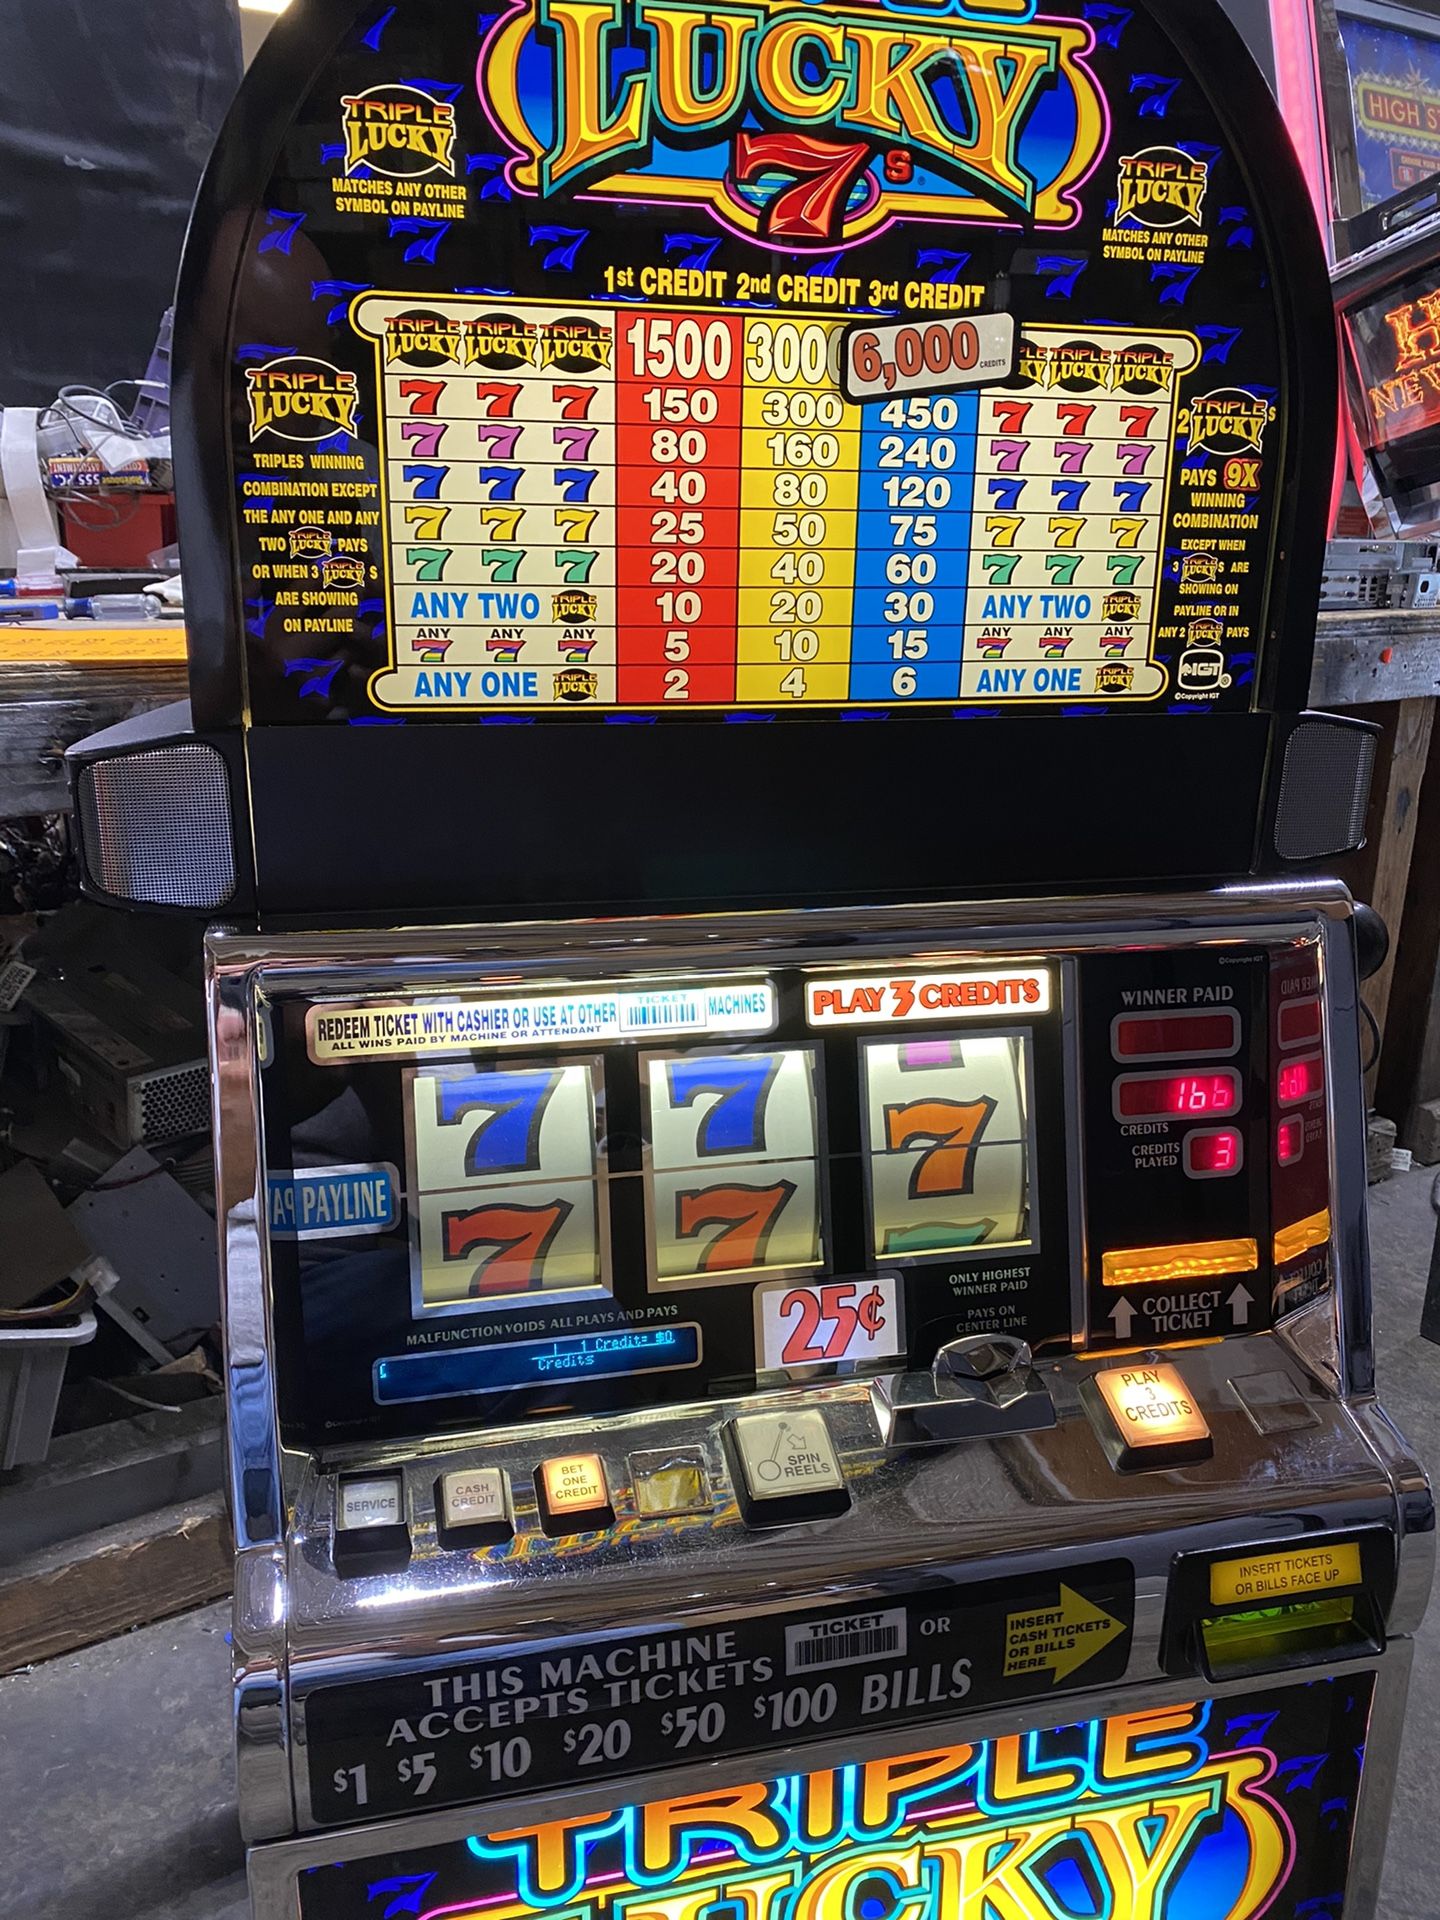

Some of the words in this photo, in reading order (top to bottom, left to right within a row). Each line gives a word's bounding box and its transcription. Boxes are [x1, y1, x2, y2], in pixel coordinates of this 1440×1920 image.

[344, 99, 452, 126] TRIPLE
[540, 2, 1060, 208] LUCKY
[1368, 92, 1420, 126] HIGH
[346, 120, 454, 167] LUCKY
[1121, 159, 1206, 181] TRIPLE
[332, 178, 393, 196] MATCHES
[395, 180, 421, 198] ANY
[425, 182, 467, 201] OTHER
[1118, 178, 1204, 219] LUCKY
[335, 197, 388, 215] SYMBOL
[391, 199, 410, 216] ON
[412, 200, 465, 219] PAYLINE
[604, 265, 634, 293] 1st
[640, 267, 728, 299] CREDIT
[736, 273, 771, 300] 2nd
[777, 275, 861, 306] CREDIT
[868, 280, 899, 307] 3rd
[904, 282, 985, 310] CREDIT
[626, 317, 733, 381] 1500
[852, 320, 980, 391] 6,000
[979, 358, 1007, 369] CREDITS
[250, 371, 356, 392] TRIPLE
[252, 389, 356, 433] LUCKY
[643, 387, 719, 424] 150
[762, 391, 844, 428] 300
[880, 396, 959, 431] 450
[650, 428, 707, 464] 80
[767, 432, 840, 467] 160
[878, 435, 957, 470] 240
[254, 454, 304, 469] TRIPLES
[310, 455, 364, 471] WINNING
[1180, 468, 1217, 488] PAYS
[1226, 461, 1261, 489] 9X
[244, 482, 328, 498] COMBINATION
[332, 482, 377, 498] EXCEPT
[650, 469, 707, 505] 40
[773, 472, 828, 507] 80
[883, 475, 952, 510] 120
[1191, 493, 1246, 509] WINNING
[244, 510, 268, 525] THE
[271, 510, 296, 525] ANY
[299, 510, 324, 525] ONE
[327, 511, 352, 525] AND
[355, 511, 379, 526] ANY
[1173, 513, 1259, 530] COMBINATION
[258, 537, 286, 552] TWO
[337, 538, 368, 552] PAYS
[1181, 539, 1217, 551] EXCEPT
[1218, 539, 1246, 551] WHEN
[252, 565, 270, 579] OR
[273, 565, 308, 579] WHEN
[275, 592, 299, 606] ARE
[302, 592, 358, 607] SHOWING
[1179, 583, 1223, 595] SHOWING
[1224, 584, 1238, 595] ON
[411, 592, 470, 619] ANY
[478, 592, 541, 620] TWO
[655, 590, 703, 624] 10
[769, 591, 823, 624] 20
[883, 590, 935, 623] 30
[1173, 605, 1212, 616] PAYLINE
[1213, 605, 1226, 616] OR
[1229, 605, 1239, 616] IN
[284, 618, 302, 633] ON
[304, 618, 353, 633] PAYLINE
[414, 672, 472, 697] ANY
[481, 672, 538, 697] ONE
[663, 668, 690, 700] 2
[780, 667, 807, 698] 4
[892, 666, 917, 697] 6
[637, 993, 688, 1004] TICKET
[812, 985, 885, 1016] PLAY
[890, 979, 915, 1017] 3
[919, 977, 1040, 1009] CREDITS
[1121, 988, 1188, 1006] WINNER
[1192, 985, 1234, 1003] PAID
[318, 1013, 370, 1041] REDEEM
[373, 1011, 418, 1037] TICKET
[422, 1009, 454, 1034] WITH
[457, 1006, 510, 1031] CASHIER
[513, 1006, 530, 1028] OR
[533, 1004, 557, 1027] USE
[560, 1003, 575, 1025] AT
[578, 1000, 617, 1025] OTHER
[707, 992, 766, 1018] MACHINES
[331, 1040, 355, 1051] ALL
[358, 1038, 392, 1049] WINS
[397, 1036, 427, 1047] PAID
[430, 1035, 447, 1045] BY
[450, 1030, 507, 1043] MACHINE
[510, 1029, 528, 1039] OR
[531, 1024, 602, 1038] ATTENDANT
[1120, 1122, 1169, 1136] CREDITS
[1131, 1142, 1180, 1156] CREDITS
[1135, 1155, 1178, 1169] PLAYED
[302, 1179, 387, 1219] PAYLINE
[948, 1270, 977, 1285] ONLY
[981, 1266, 1031, 1282] HIGHEST
[953, 1281, 996, 1296] WINNER
[999, 1278, 1028, 1292] PAID
[967, 1306, 995, 1320] PAYS
[998, 1305, 1016, 1317] ON
[1142, 1291, 1221, 1314] COLLECT
[405, 1324, 503, 1346] MALFUNCTION
[505, 1320, 546, 1335] VOIDS
[550, 1315, 573, 1329] ALL
[575, 1311, 615, 1327] PLAYS
[617, 1307, 644, 1321] AND
[645, 1304, 678, 1319] PAYS
[779, 1283, 888, 1365] 25¢
[955, 1318, 999, 1334] CENTER
[1002, 1315, 1028, 1328] LINE
[1151, 1310, 1213, 1333] TICKET
[538, 1353, 595, 1371] Credits
[1120, 1369, 1161, 1386] PLAY
[1125, 1399, 1194, 1422] CREDITS
[561, 1464, 584, 1475] BET
[784, 1462, 832, 1478] REELS
[787, 1452, 821, 1466] SPIN
[455, 1483, 489, 1496] CASH
[555, 1484, 599, 1500] CREDIT
[562, 1475, 588, 1487] ONE
[346, 1497, 396, 1513] SERVICE
[451, 1493, 495, 1507] CREDIT
[1240, 1561, 1281, 1578] INSERT
[1285, 1554, 1333, 1570] TICKETS
[1235, 1582, 1253, 1595] OR
[1256, 1577, 1287, 1592] BILLS
[1291, 1571, 1321, 1586] FACE
[1324, 1568, 1339, 1581] UP
[808, 1613, 884, 1638] TICKET
[919, 1616, 952, 1636] OR
[1009, 1629, 1048, 1645] CASH
[1052, 1619, 1111, 1638] TICKETS
[1010, 1611, 1064, 1631] INSERT
[1009, 1646, 1029, 1658] OR
[1034, 1639, 1075, 1654] BILLS
[424, 1666, 524, 1707] THIS
[540, 1631, 736, 1689] MACHINE
[1007, 1656, 1047, 1671] HERE
[386, 1688, 590, 1747] ACCEPTS
[603, 1656, 773, 1707] TICKETS
[333, 1763, 368, 1806] $1
[397, 1752, 438, 1796] $5
[469, 1736, 532, 1782] $10
[563, 1719, 632, 1766] $20
[660, 1702, 726, 1749] $50
[753, 1686, 838, 1732] $100
[859, 1657, 973, 1716] BILLS
[480, 1699, 1202, 1893] TRIPLE
